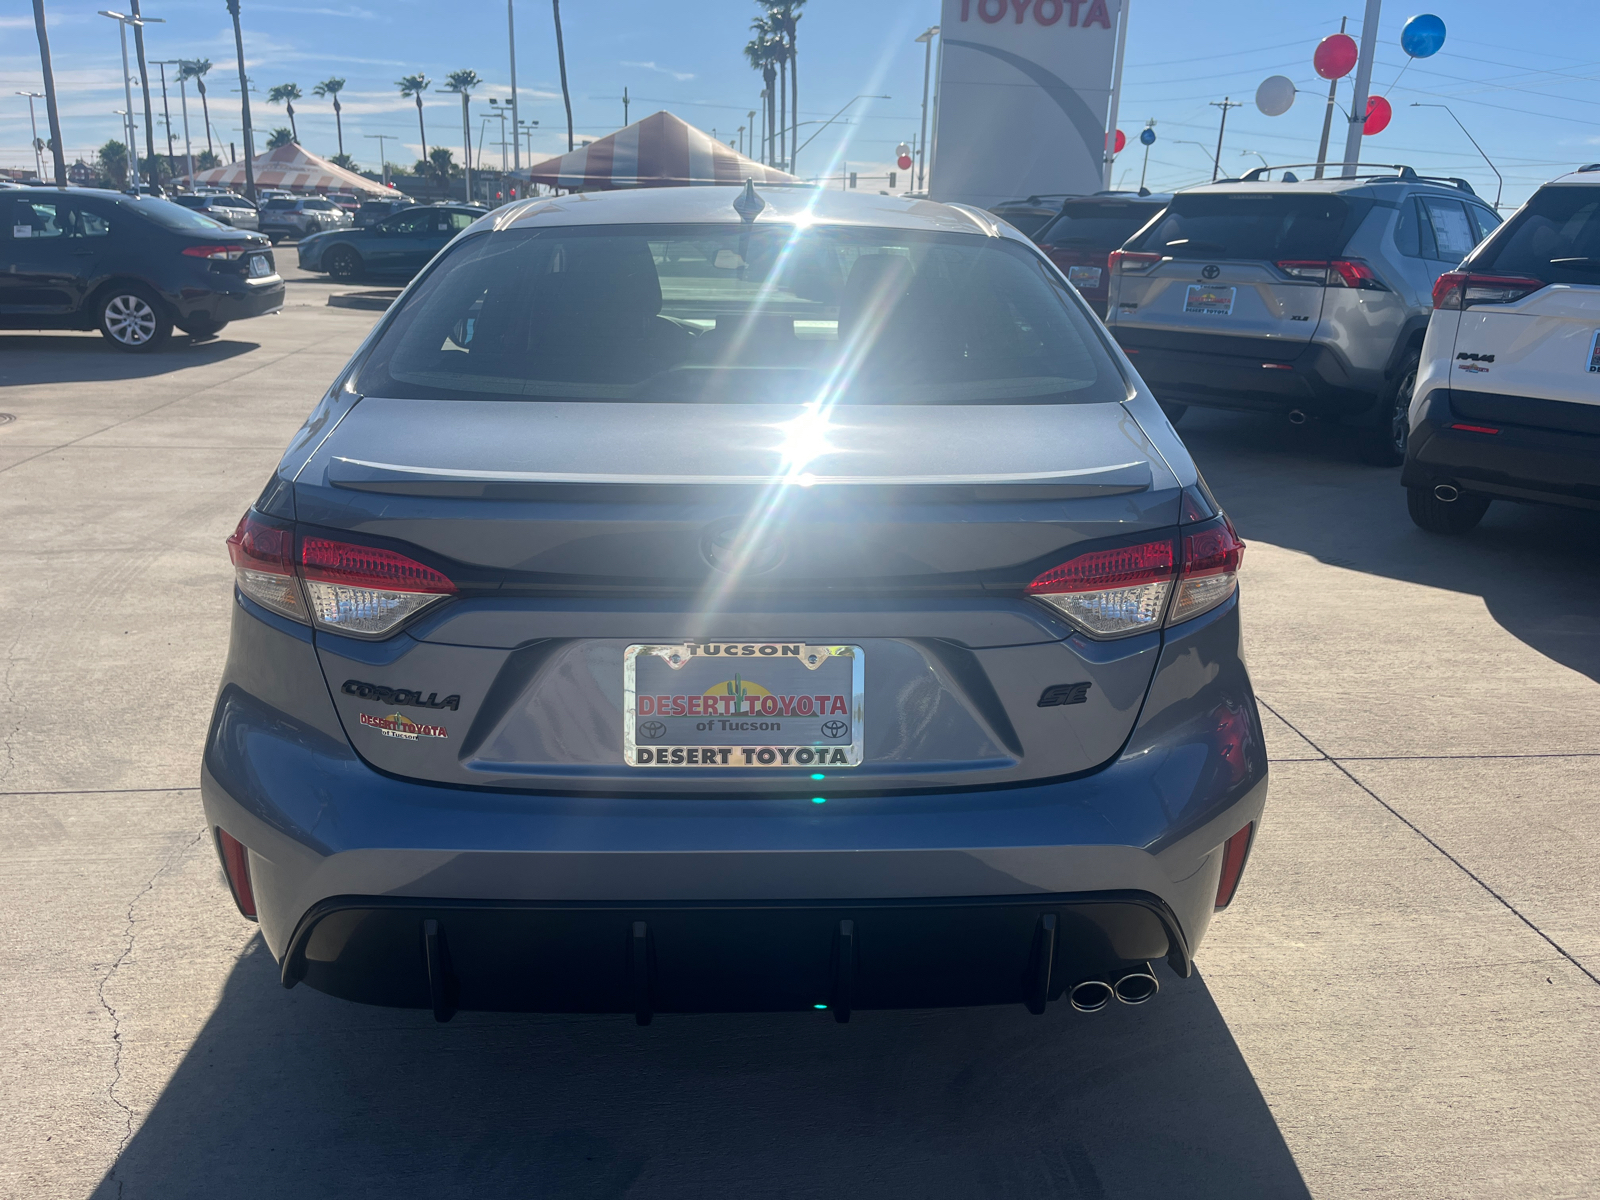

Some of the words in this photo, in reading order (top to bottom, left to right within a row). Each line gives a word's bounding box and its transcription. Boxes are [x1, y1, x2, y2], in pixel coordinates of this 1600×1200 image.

[687, 644, 800, 656] TUCSON
[341, 679, 461, 711] COROLLA
[1037, 681, 1093, 707] SE
[638, 695, 736, 716] DESERT
[744, 695, 848, 716] TOYOTA
[360, 713, 398, 731] DESERT
[402, 721, 447, 738] TOYOTA
[696, 720, 715, 731] of
[718, 720, 781, 731] Tucson
[637, 747, 733, 765] DESERT
[742, 747, 849, 765] TOYOTA
